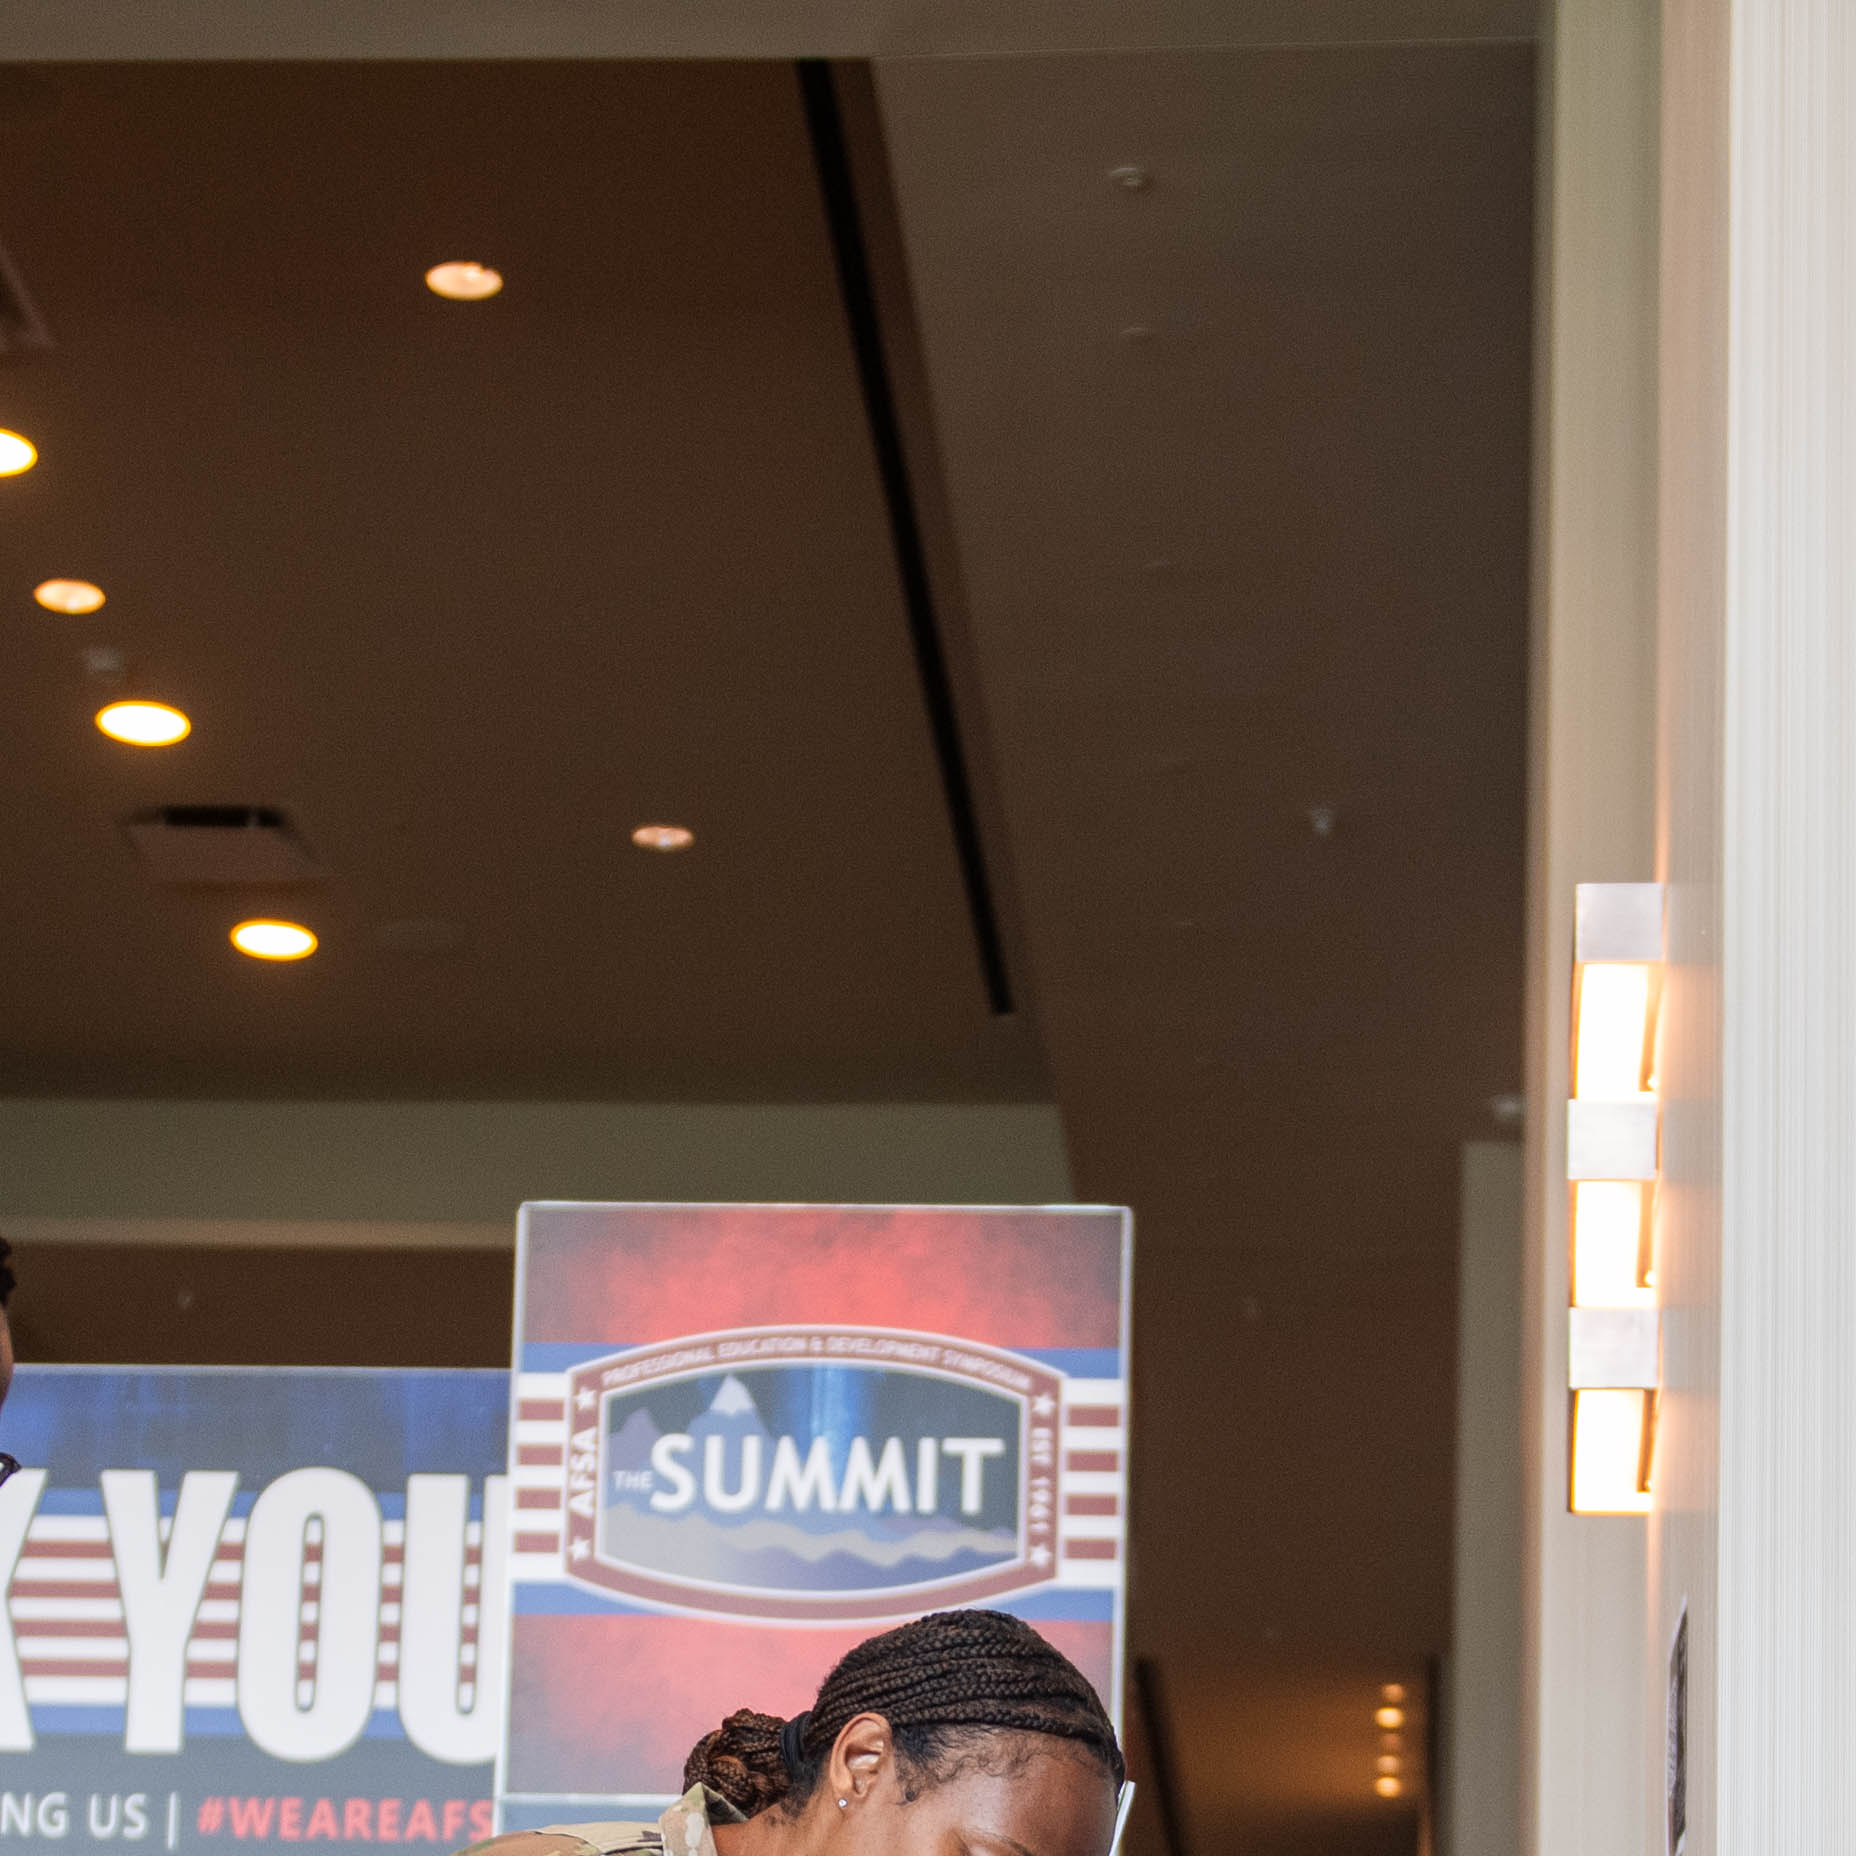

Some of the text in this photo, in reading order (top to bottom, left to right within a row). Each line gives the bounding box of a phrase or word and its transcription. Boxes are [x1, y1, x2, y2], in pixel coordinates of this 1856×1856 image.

[601, 1345, 715, 1387] PROFESSIONAL
[717, 1336, 808, 1359] EDUCATION
[567, 1425, 597, 1518] AFSA
[614, 1468, 653, 1491] THE
[649, 1432, 1006, 1515] SUMMIT
[100, 1465, 508, 1766] YOU
[88, 1792, 148, 1839] US
[197, 1796, 496, 1843] #WEAREAFS
